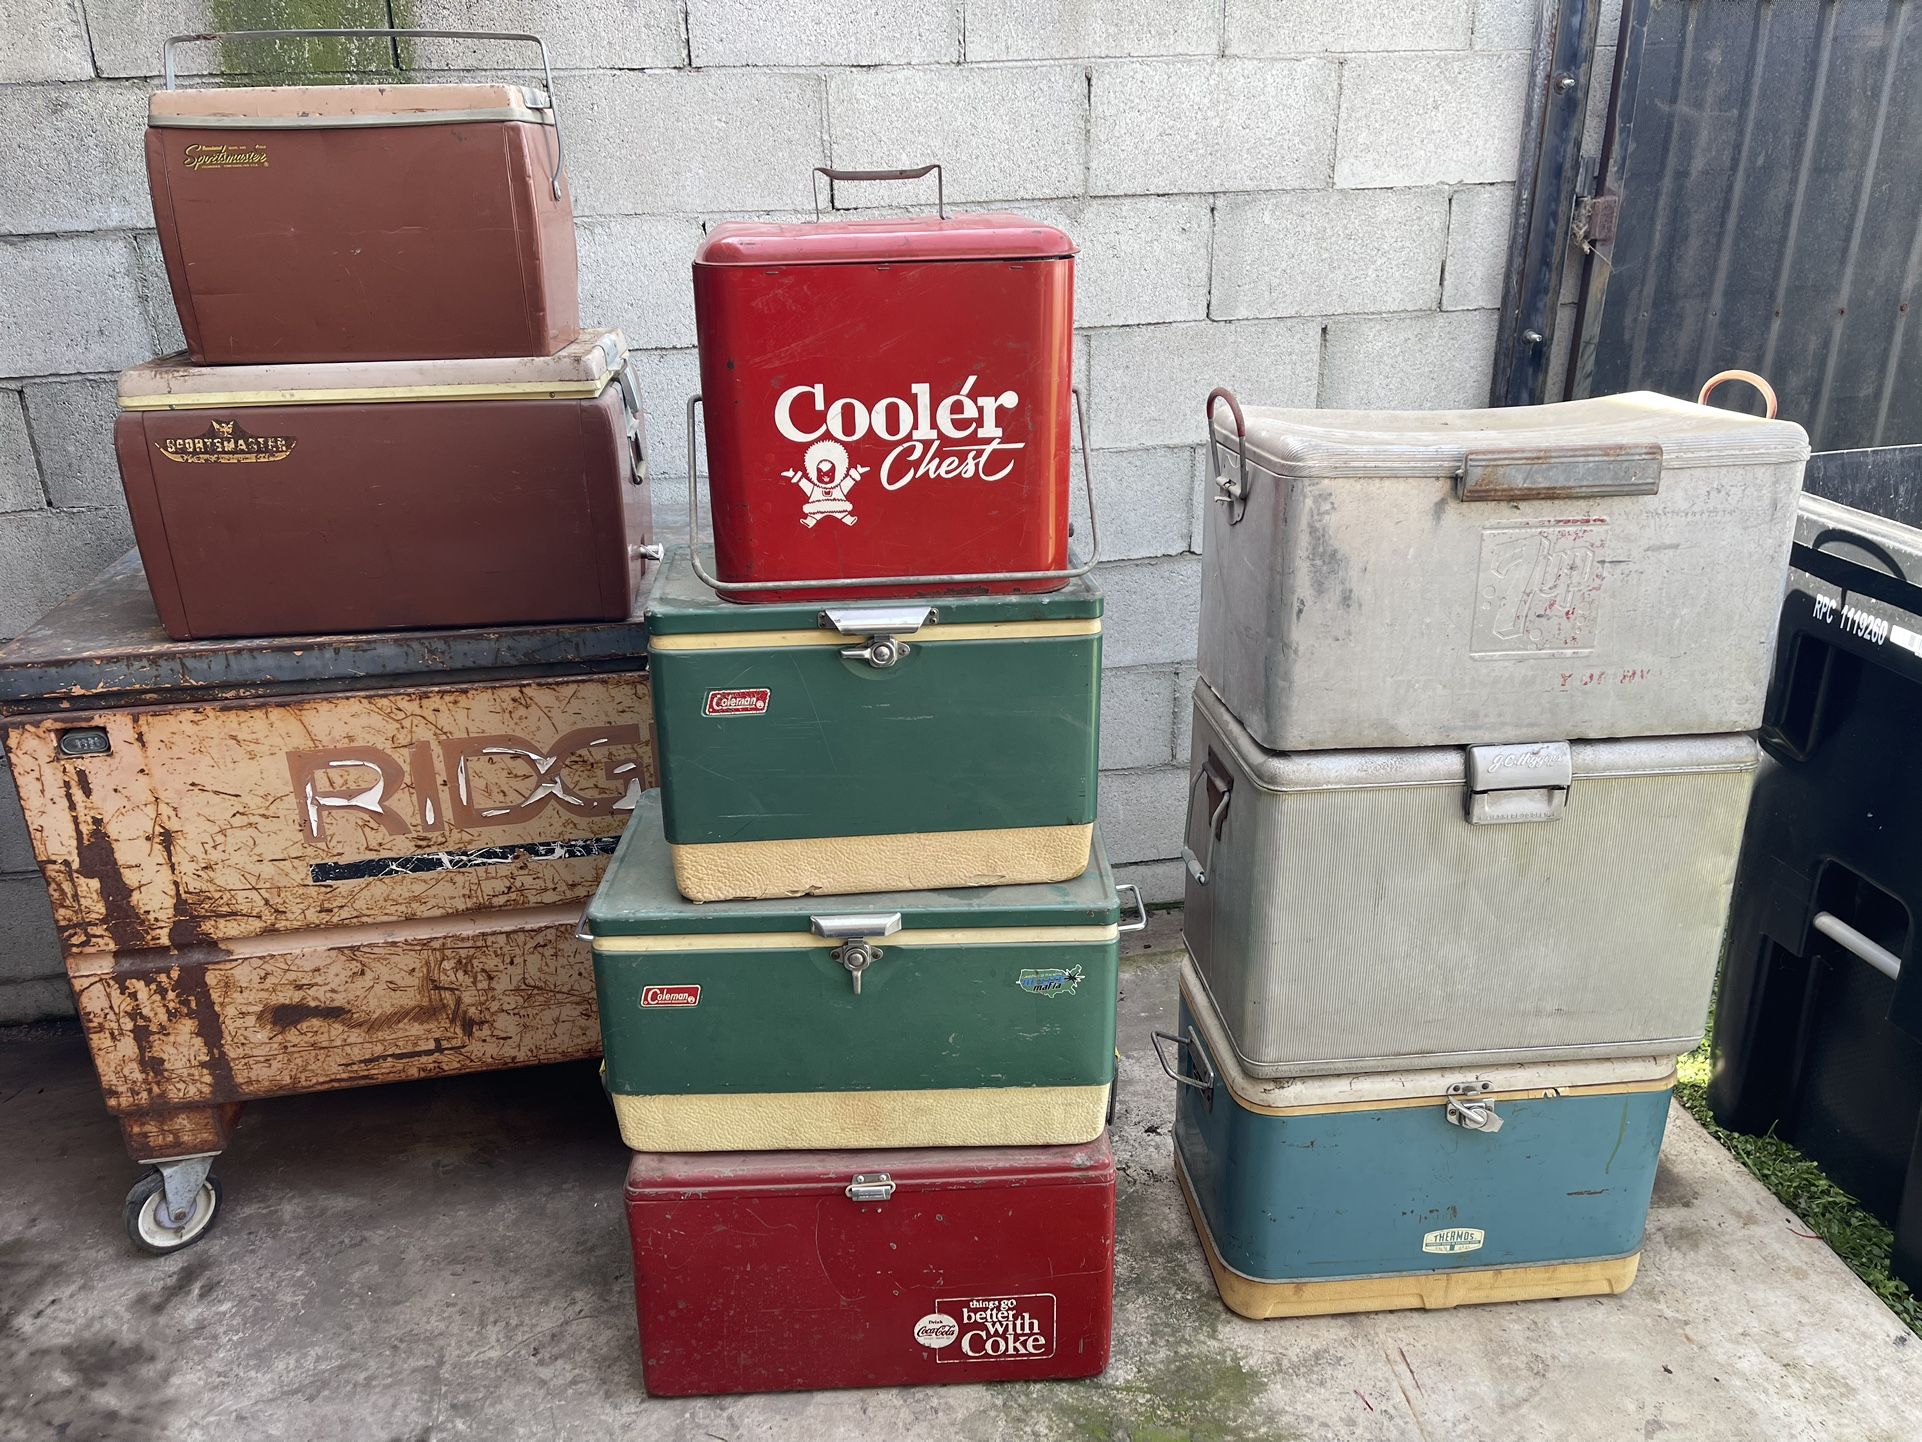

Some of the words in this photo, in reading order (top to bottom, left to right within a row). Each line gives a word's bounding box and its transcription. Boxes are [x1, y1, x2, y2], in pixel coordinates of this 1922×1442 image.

[184, 144, 268, 171] Sportsmaster
[774, 375, 1019, 443] Coolér
[166, 438, 287, 452] SPORTSMASTER
[879, 438, 1026, 491] Chest
[1812, 593, 1837, 624] RPC
[1840, 604, 1889, 646] 1119260
[712, 694, 757, 710] Coleman
[285, 722, 658, 844] RIDG
[647, 988, 689, 1005] Coleman
[1433, 1230, 1475, 1242] THERMOS
[962, 1308, 1017, 1324] better
[969, 1300, 999, 1309] things
[1000, 1298, 1017, 1311] go
[984, 1312, 1041, 1336] with
[960, 1329, 1046, 1357] Coke
